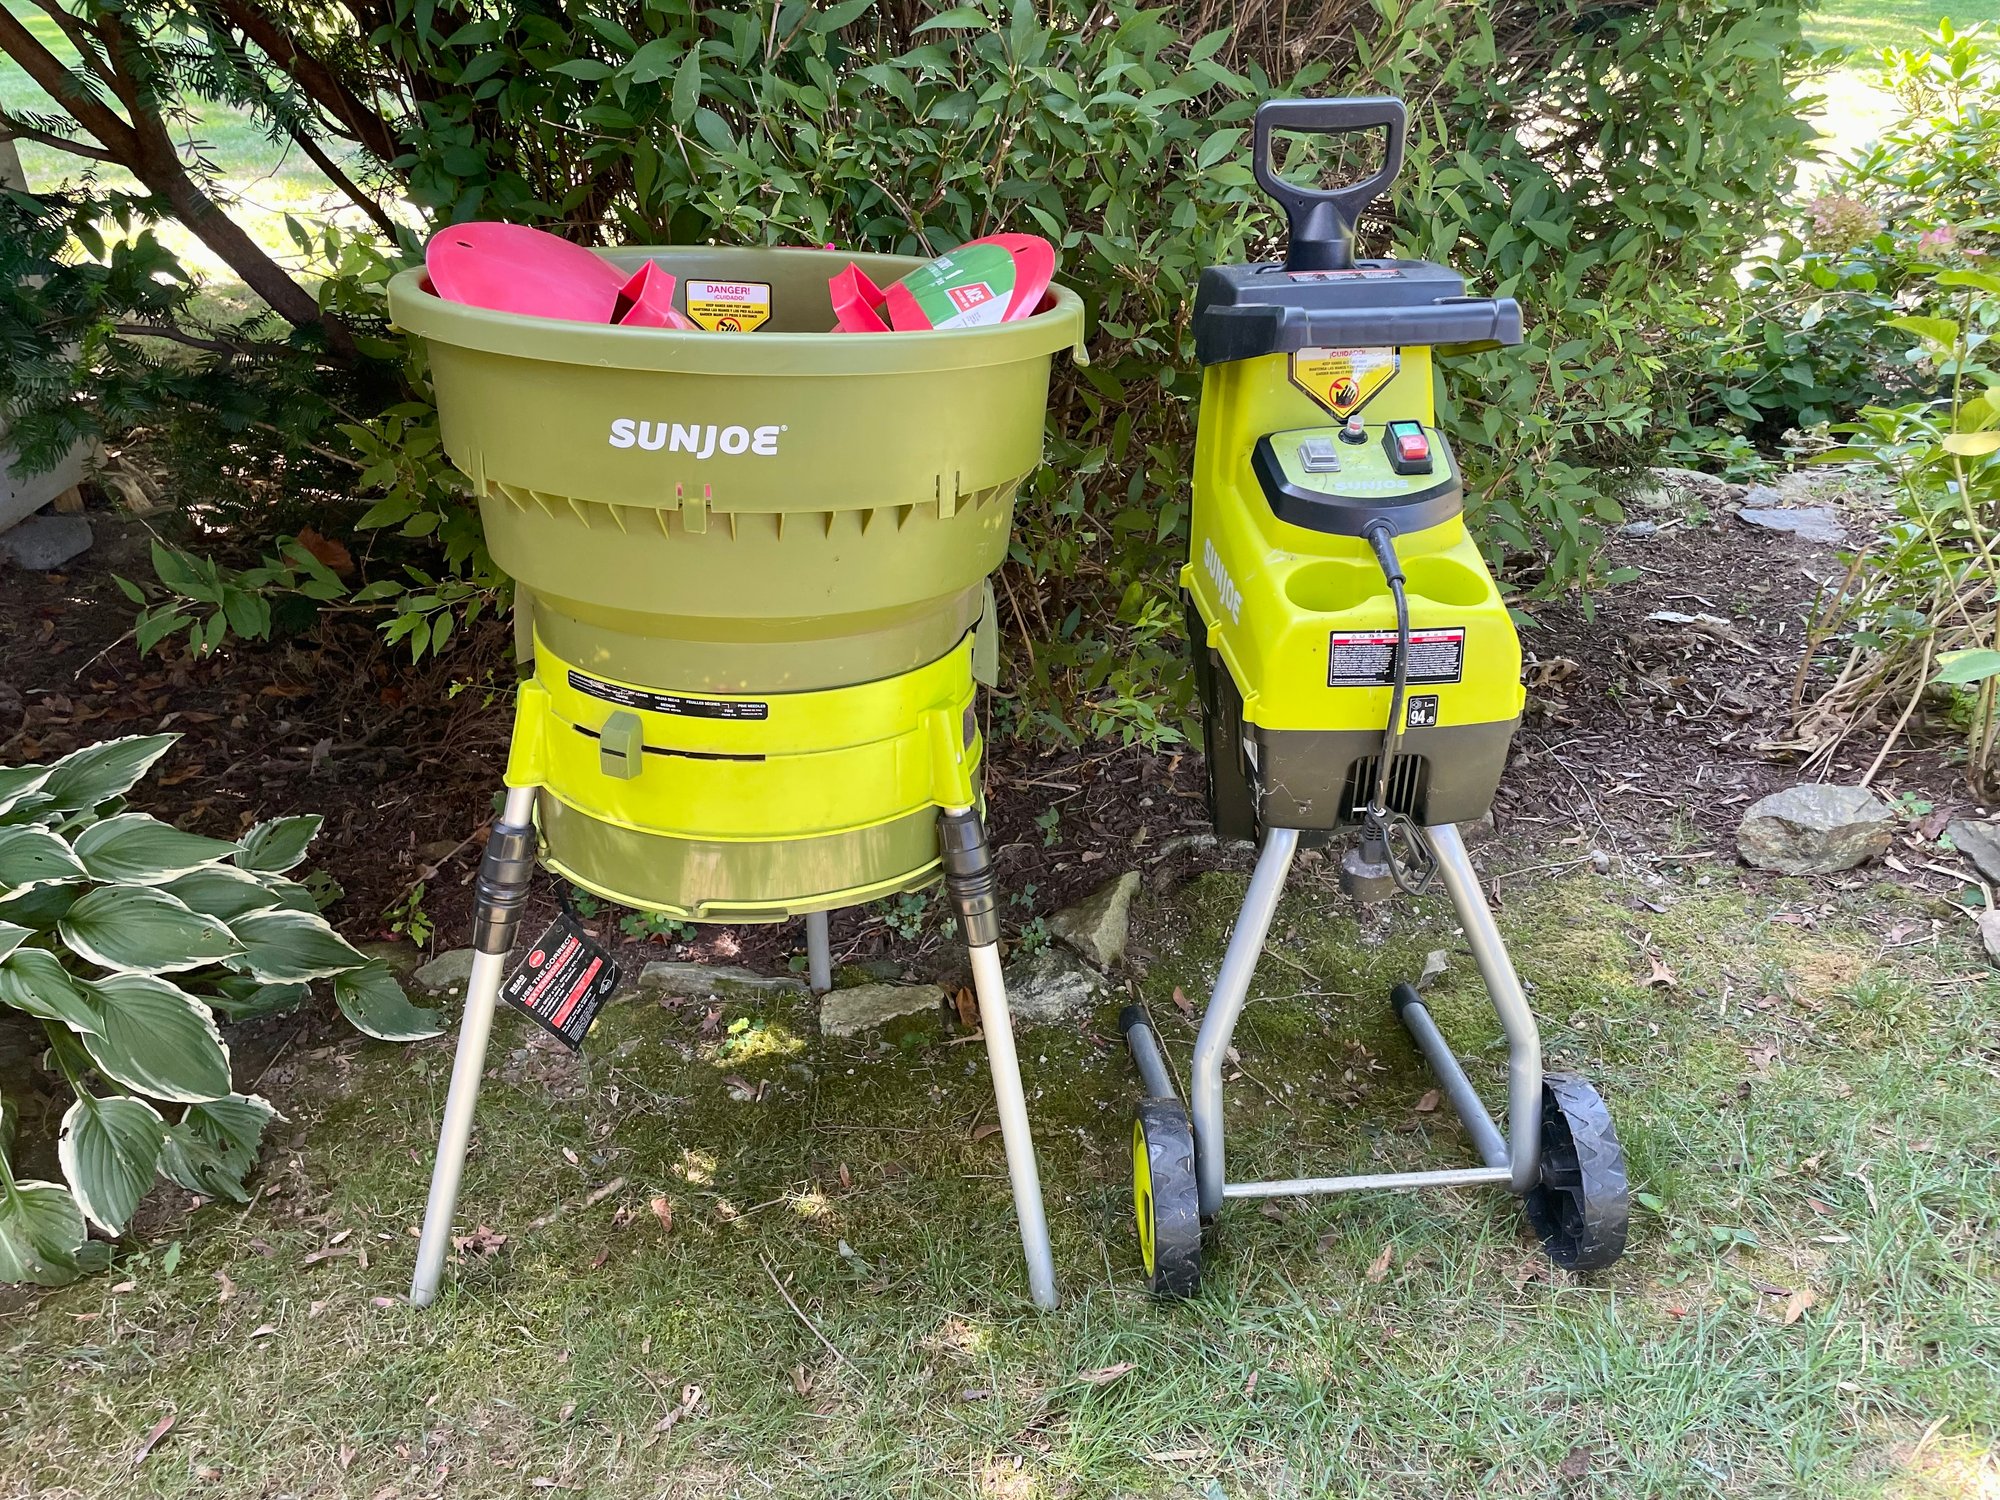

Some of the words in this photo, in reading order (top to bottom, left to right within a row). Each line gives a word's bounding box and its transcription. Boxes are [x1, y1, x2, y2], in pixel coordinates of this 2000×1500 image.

[707, 285, 750, 295] DANGER!
[1334, 480, 1409, 491] SUNJOE
[1204, 538, 1242, 626] SUNJOE
[1410, 710, 1426, 724] 94
[520, 985, 534, 1001] USE
[532, 970, 546, 985] THE
[545, 933, 573, 969] CORRECT
[528, 962, 560, 1003] EXTENSION
[558, 941, 576, 963] CORD
[509, 974, 525, 994] READ
